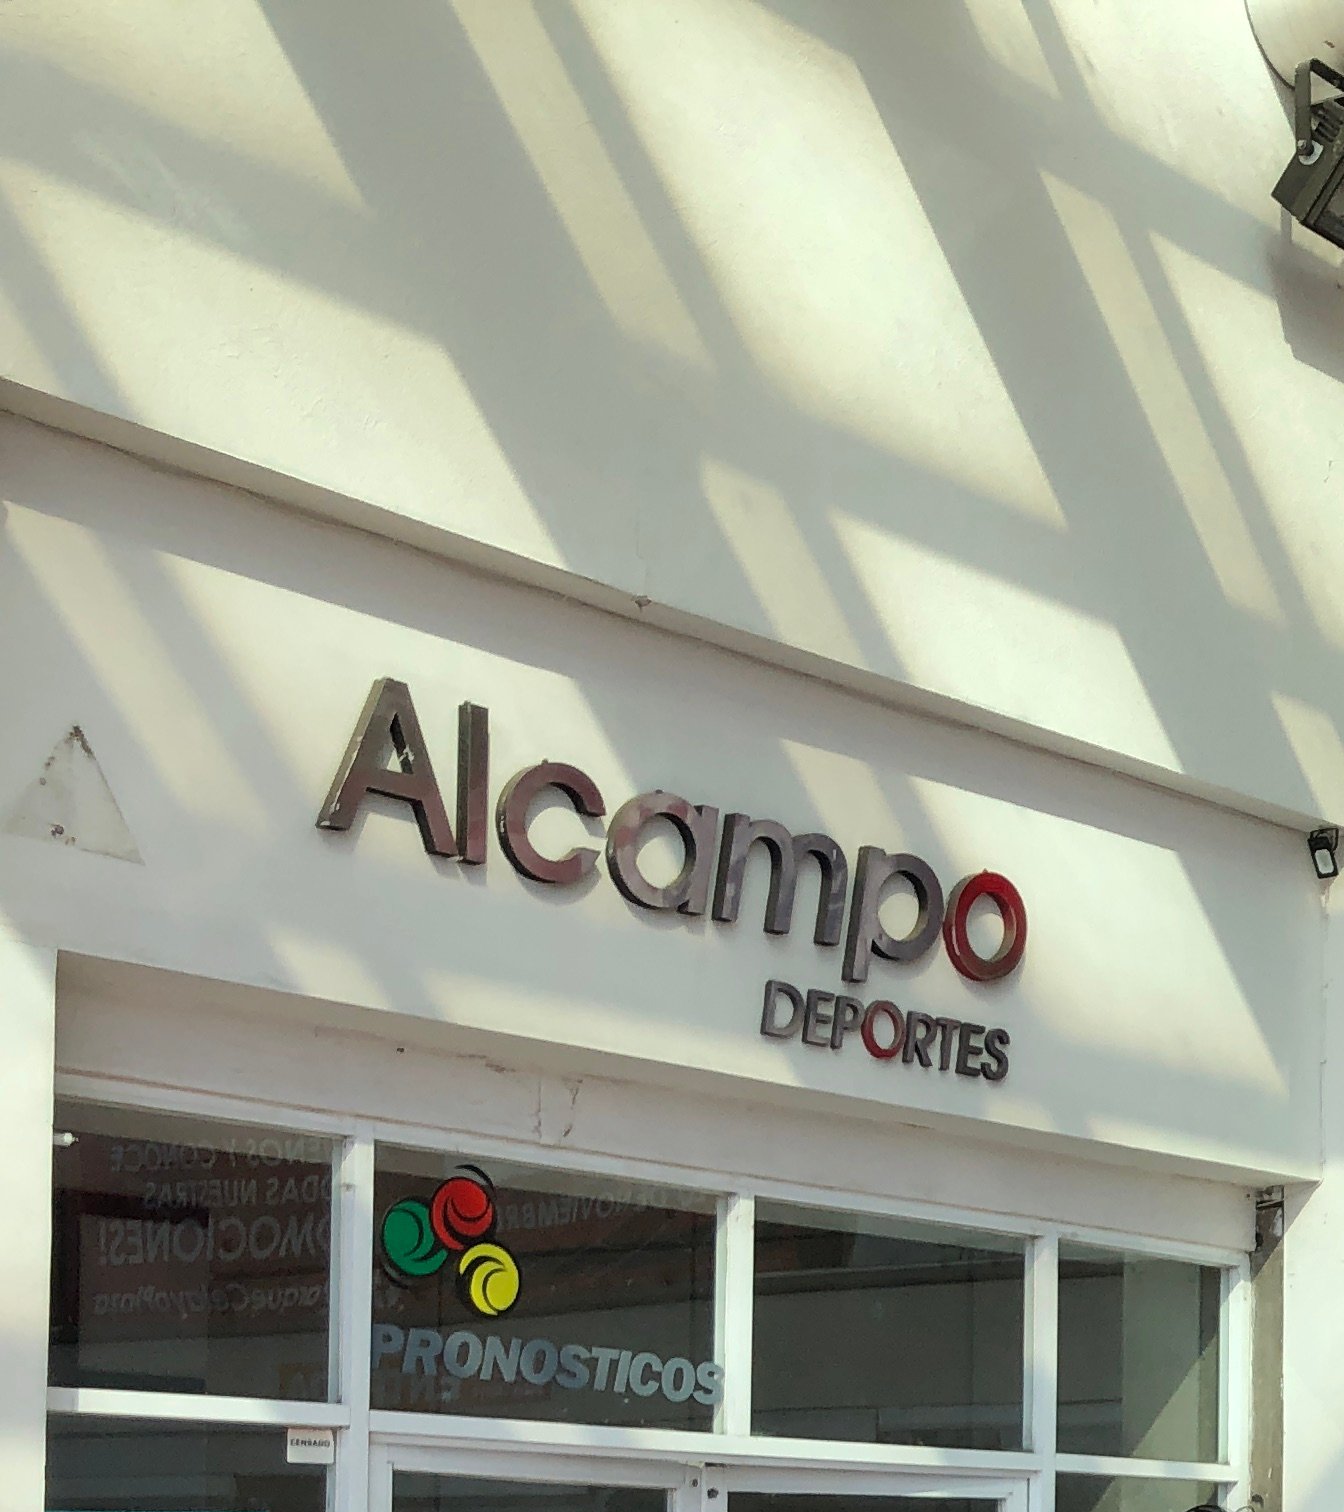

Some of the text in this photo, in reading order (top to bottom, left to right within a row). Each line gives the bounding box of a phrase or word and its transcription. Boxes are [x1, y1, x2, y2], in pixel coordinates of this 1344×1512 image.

[316, 677, 1028, 984] Alcampo
[762, 978, 1010, 1081] DEPORTES
[371, 1324, 726, 1405] PRONOSTICOS
